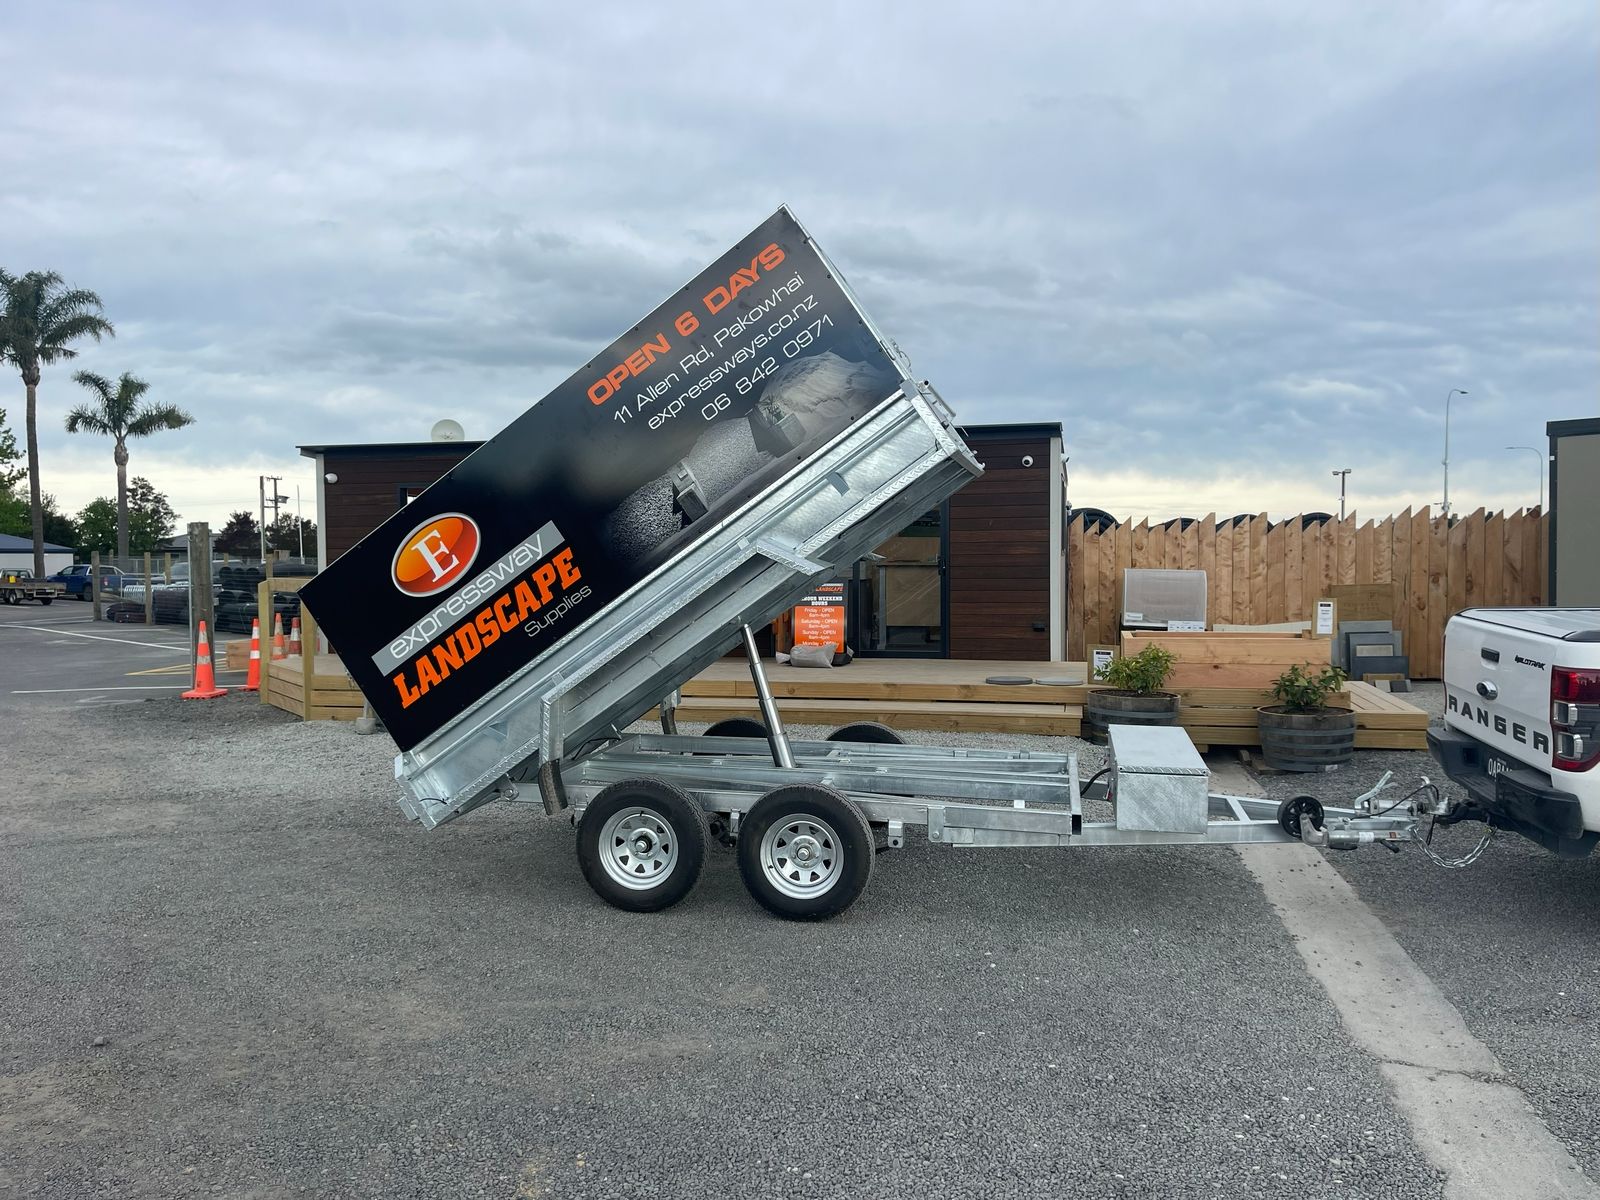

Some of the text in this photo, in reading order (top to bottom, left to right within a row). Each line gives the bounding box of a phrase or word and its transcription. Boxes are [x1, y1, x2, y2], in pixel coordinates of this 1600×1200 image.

[587, 242, 785, 406] OPEN 6 DAYS
[613, 271, 805, 424] 11 Allen Rd, Pakowhai
[648, 293, 818, 430] expressways.co.nz
[701, 313, 834, 421] 06 842 0971
[389, 533, 545, 659] expressway
[411, 529, 460, 583] E
[524, 585, 592, 638] Supplies
[393, 547, 582, 709] LANDSCAPE
[1514, 654, 1546, 671] WILDTRAK
[1448, 693, 1550, 755] RANGER
